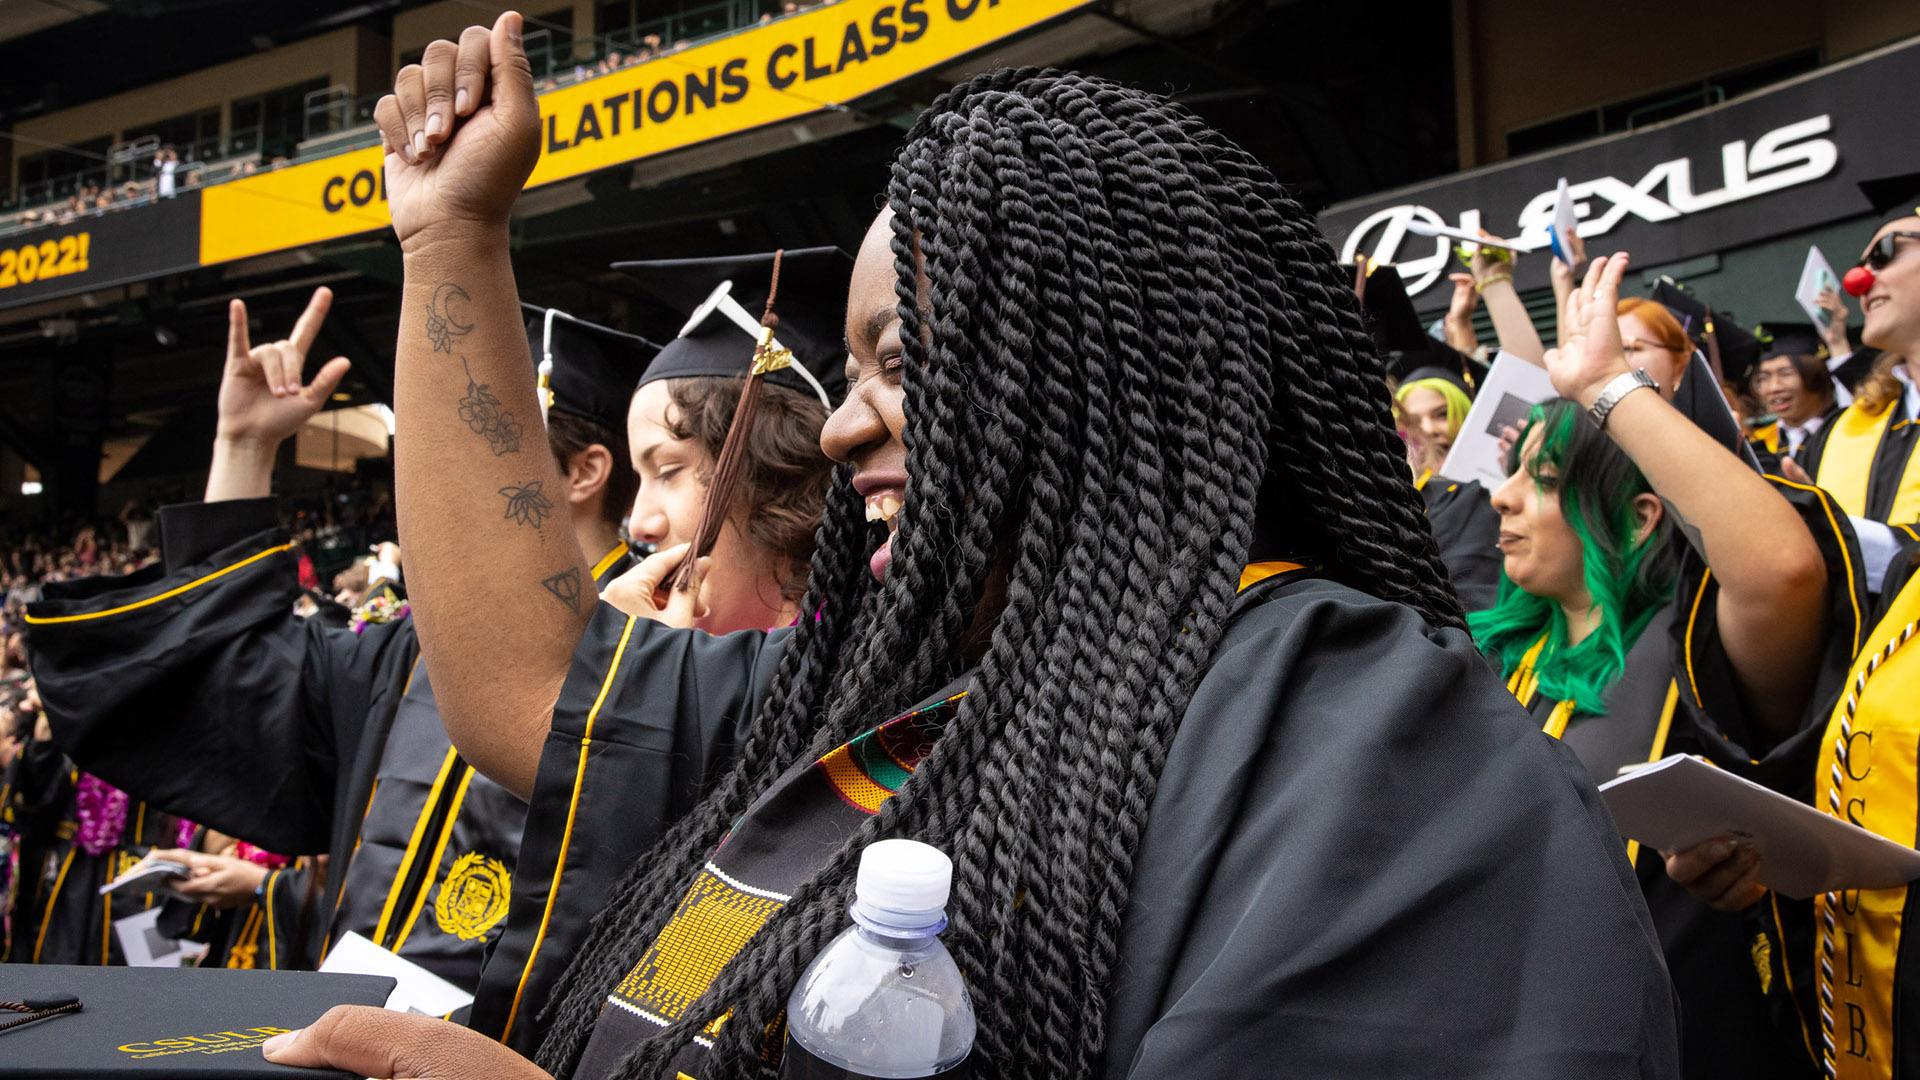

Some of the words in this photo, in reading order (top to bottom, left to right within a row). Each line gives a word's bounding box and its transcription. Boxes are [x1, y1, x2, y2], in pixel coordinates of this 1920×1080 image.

[766, 0, 929, 90] CLASS
[1459, 114, 1838, 254] LEXUS
[0, 232, 90, 289] 2022!
[117, 1026, 292, 1053] CSULB
